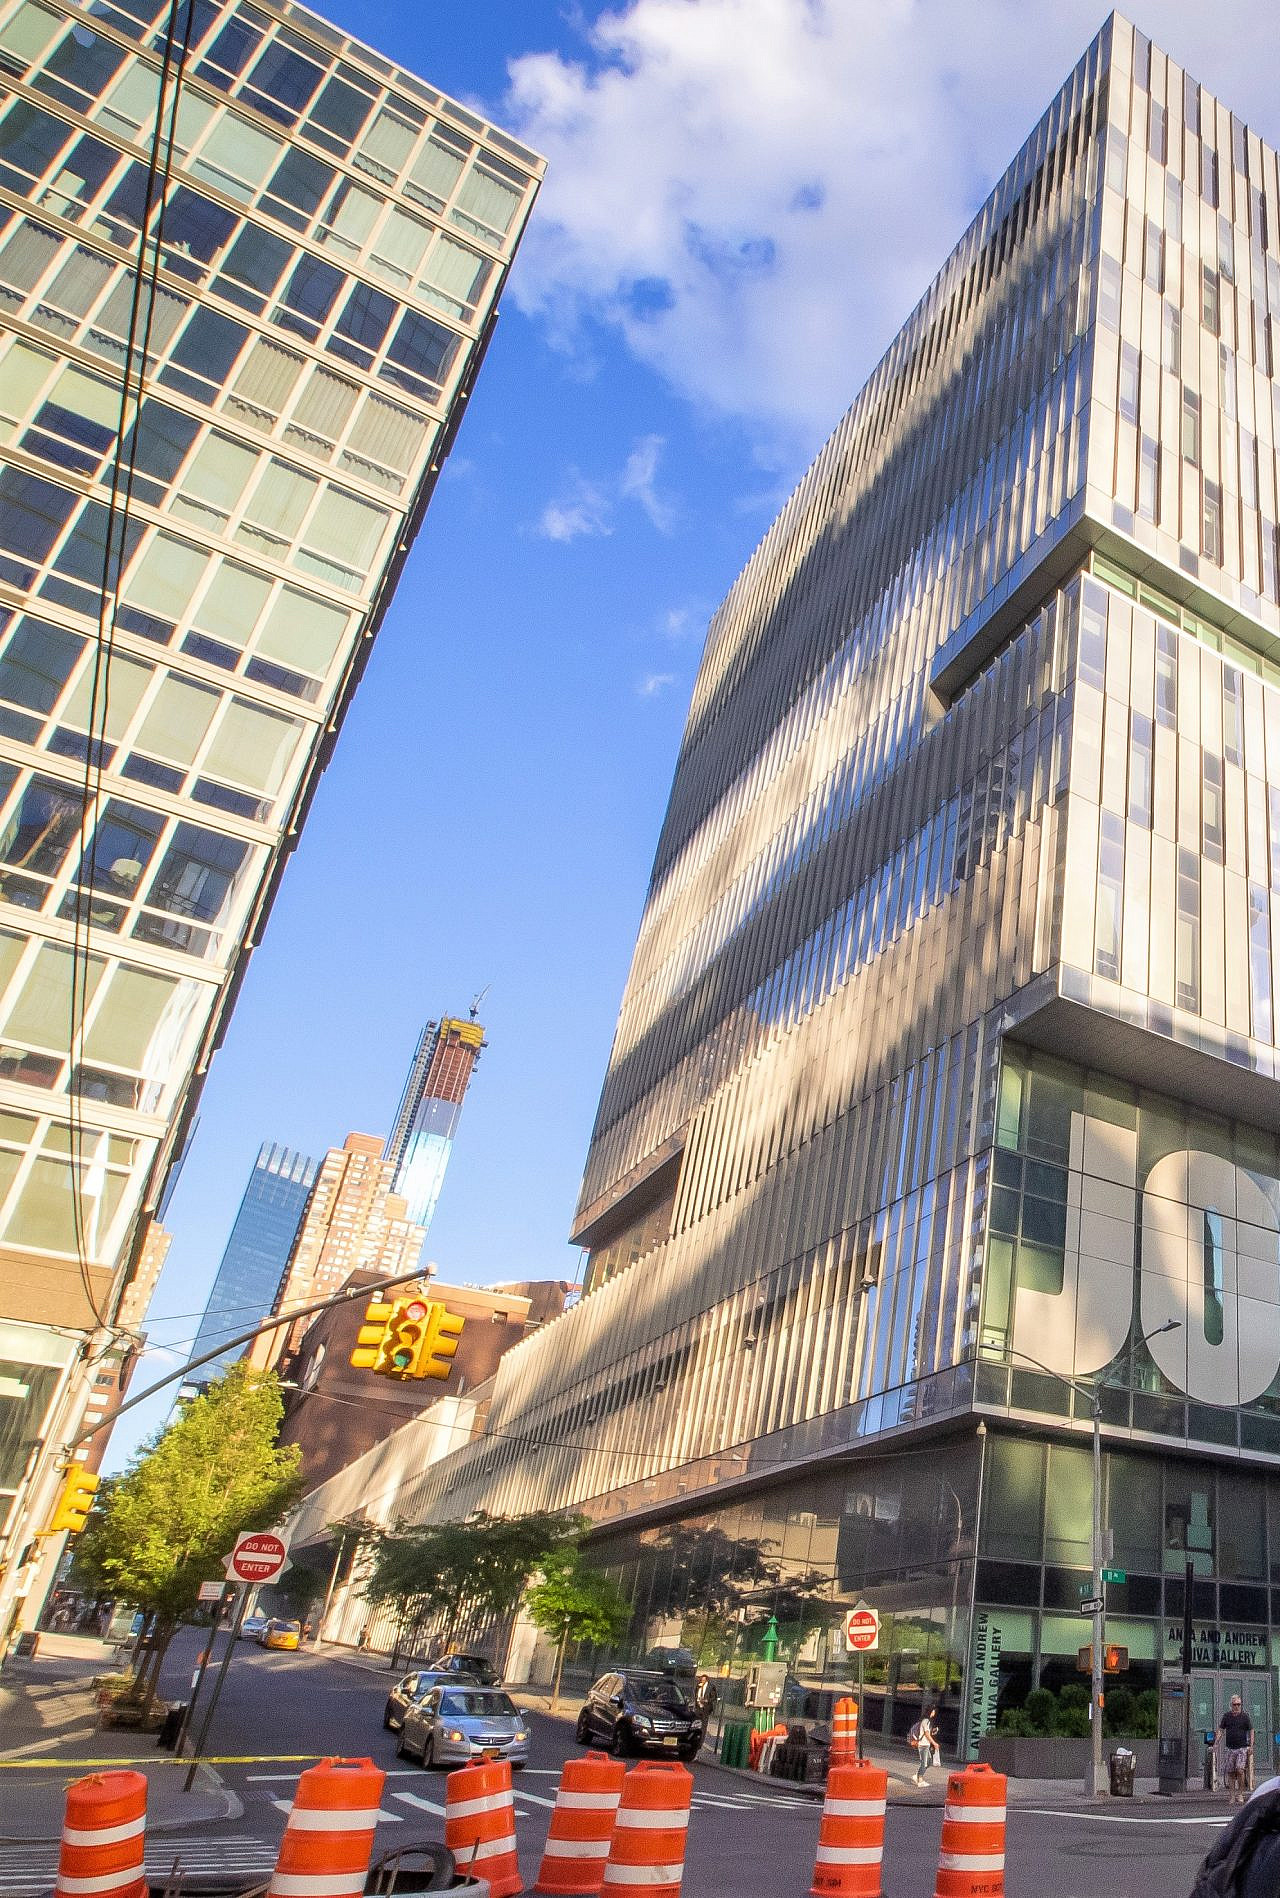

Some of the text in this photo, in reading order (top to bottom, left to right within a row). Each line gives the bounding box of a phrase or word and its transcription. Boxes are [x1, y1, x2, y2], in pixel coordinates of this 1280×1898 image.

[246, 1542, 279, 1552] DO NOT
[241, 1563, 270, 1573] ENTER
[862, 1617, 872, 1625] NOT
[1168, 1627, 1268, 1647] ANA AND ANDREW
[989, 1627, 1002, 1688] GALLERY
[1213, 1648, 1257, 1664] GALLERY
[970, 1612, 989, 1751] ANYA AND ANDREW
